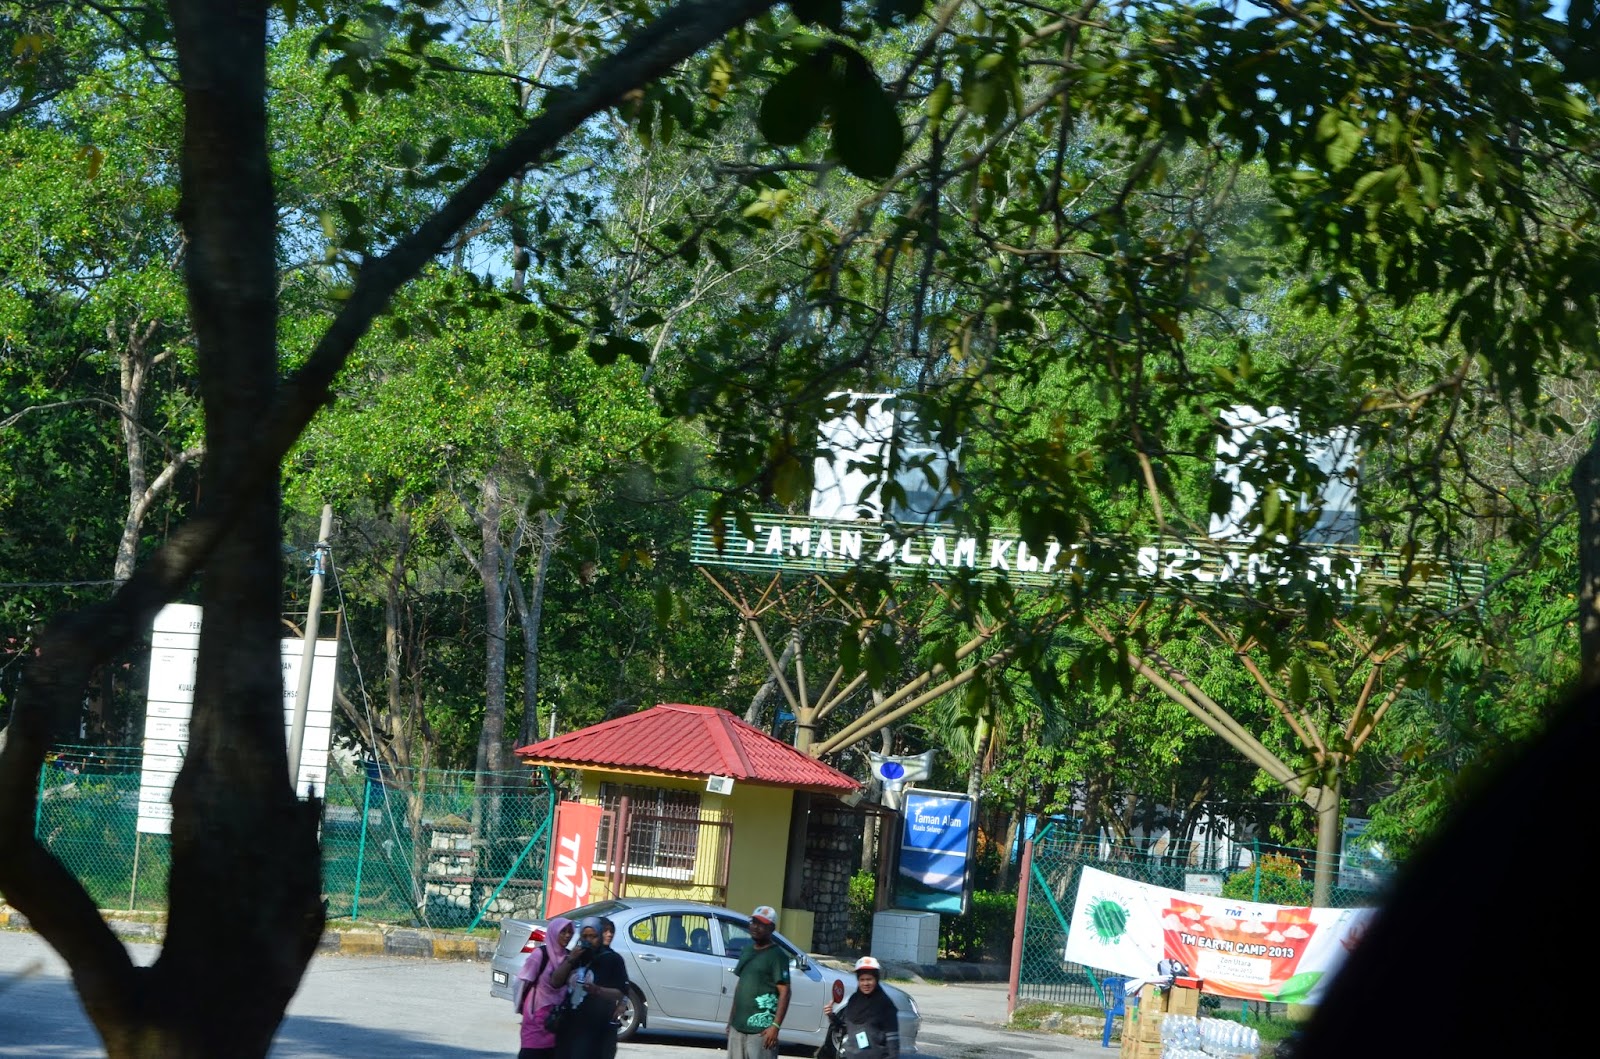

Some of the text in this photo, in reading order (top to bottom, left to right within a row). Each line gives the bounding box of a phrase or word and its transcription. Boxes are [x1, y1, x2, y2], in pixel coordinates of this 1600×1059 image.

[877, 533, 976, 568] ALAM
[915, 812, 962, 827] Taman Alam
[913, 824, 926, 832] Kuala
[555, 833, 581, 898] TM
[1225, 908, 1242, 917] TM
[1180, 933, 1295, 958] TM EARTH CAMP 2013
[1233, 958, 1252, 967] Utara
